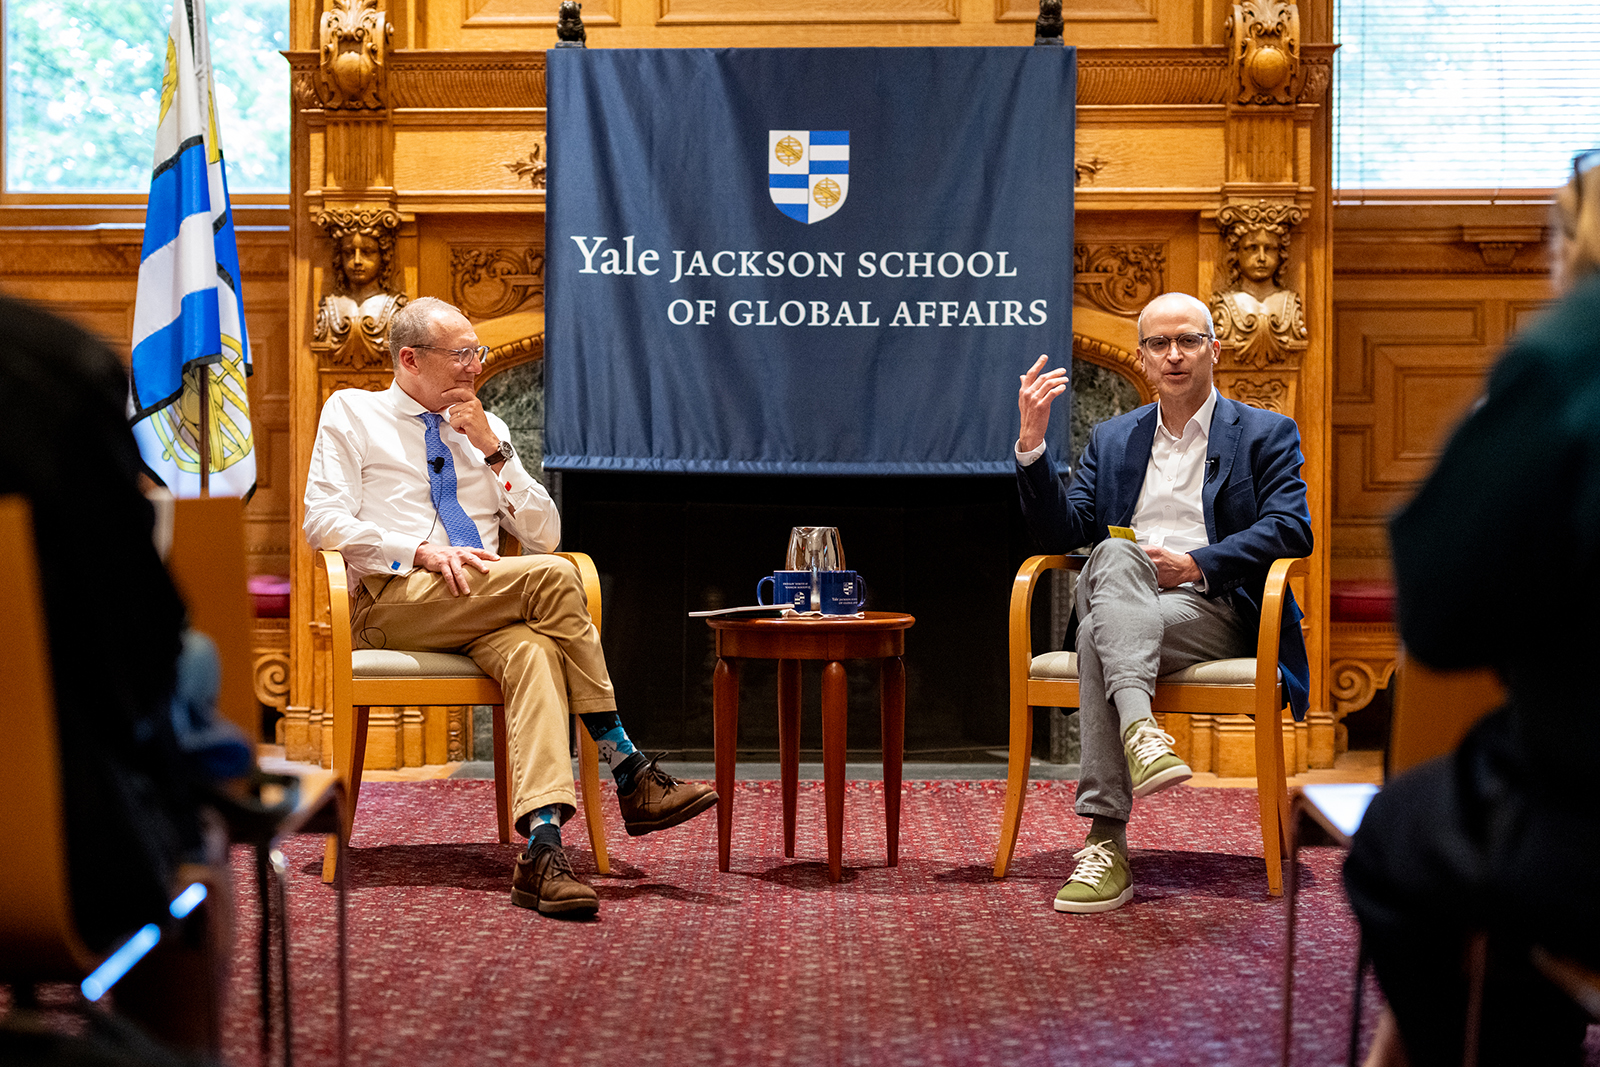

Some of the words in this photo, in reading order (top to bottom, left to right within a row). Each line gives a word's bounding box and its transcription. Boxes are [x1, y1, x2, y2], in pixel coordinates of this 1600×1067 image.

[570, 235, 660, 276] Yale
[669, 250, 846, 283] JACKSON
[857, 251, 1018, 277] SCHOOL
[667, 298, 716, 326] OF
[728, 299, 880, 327] GLOBAL
[888, 299, 1048, 326] AFFAIRS
